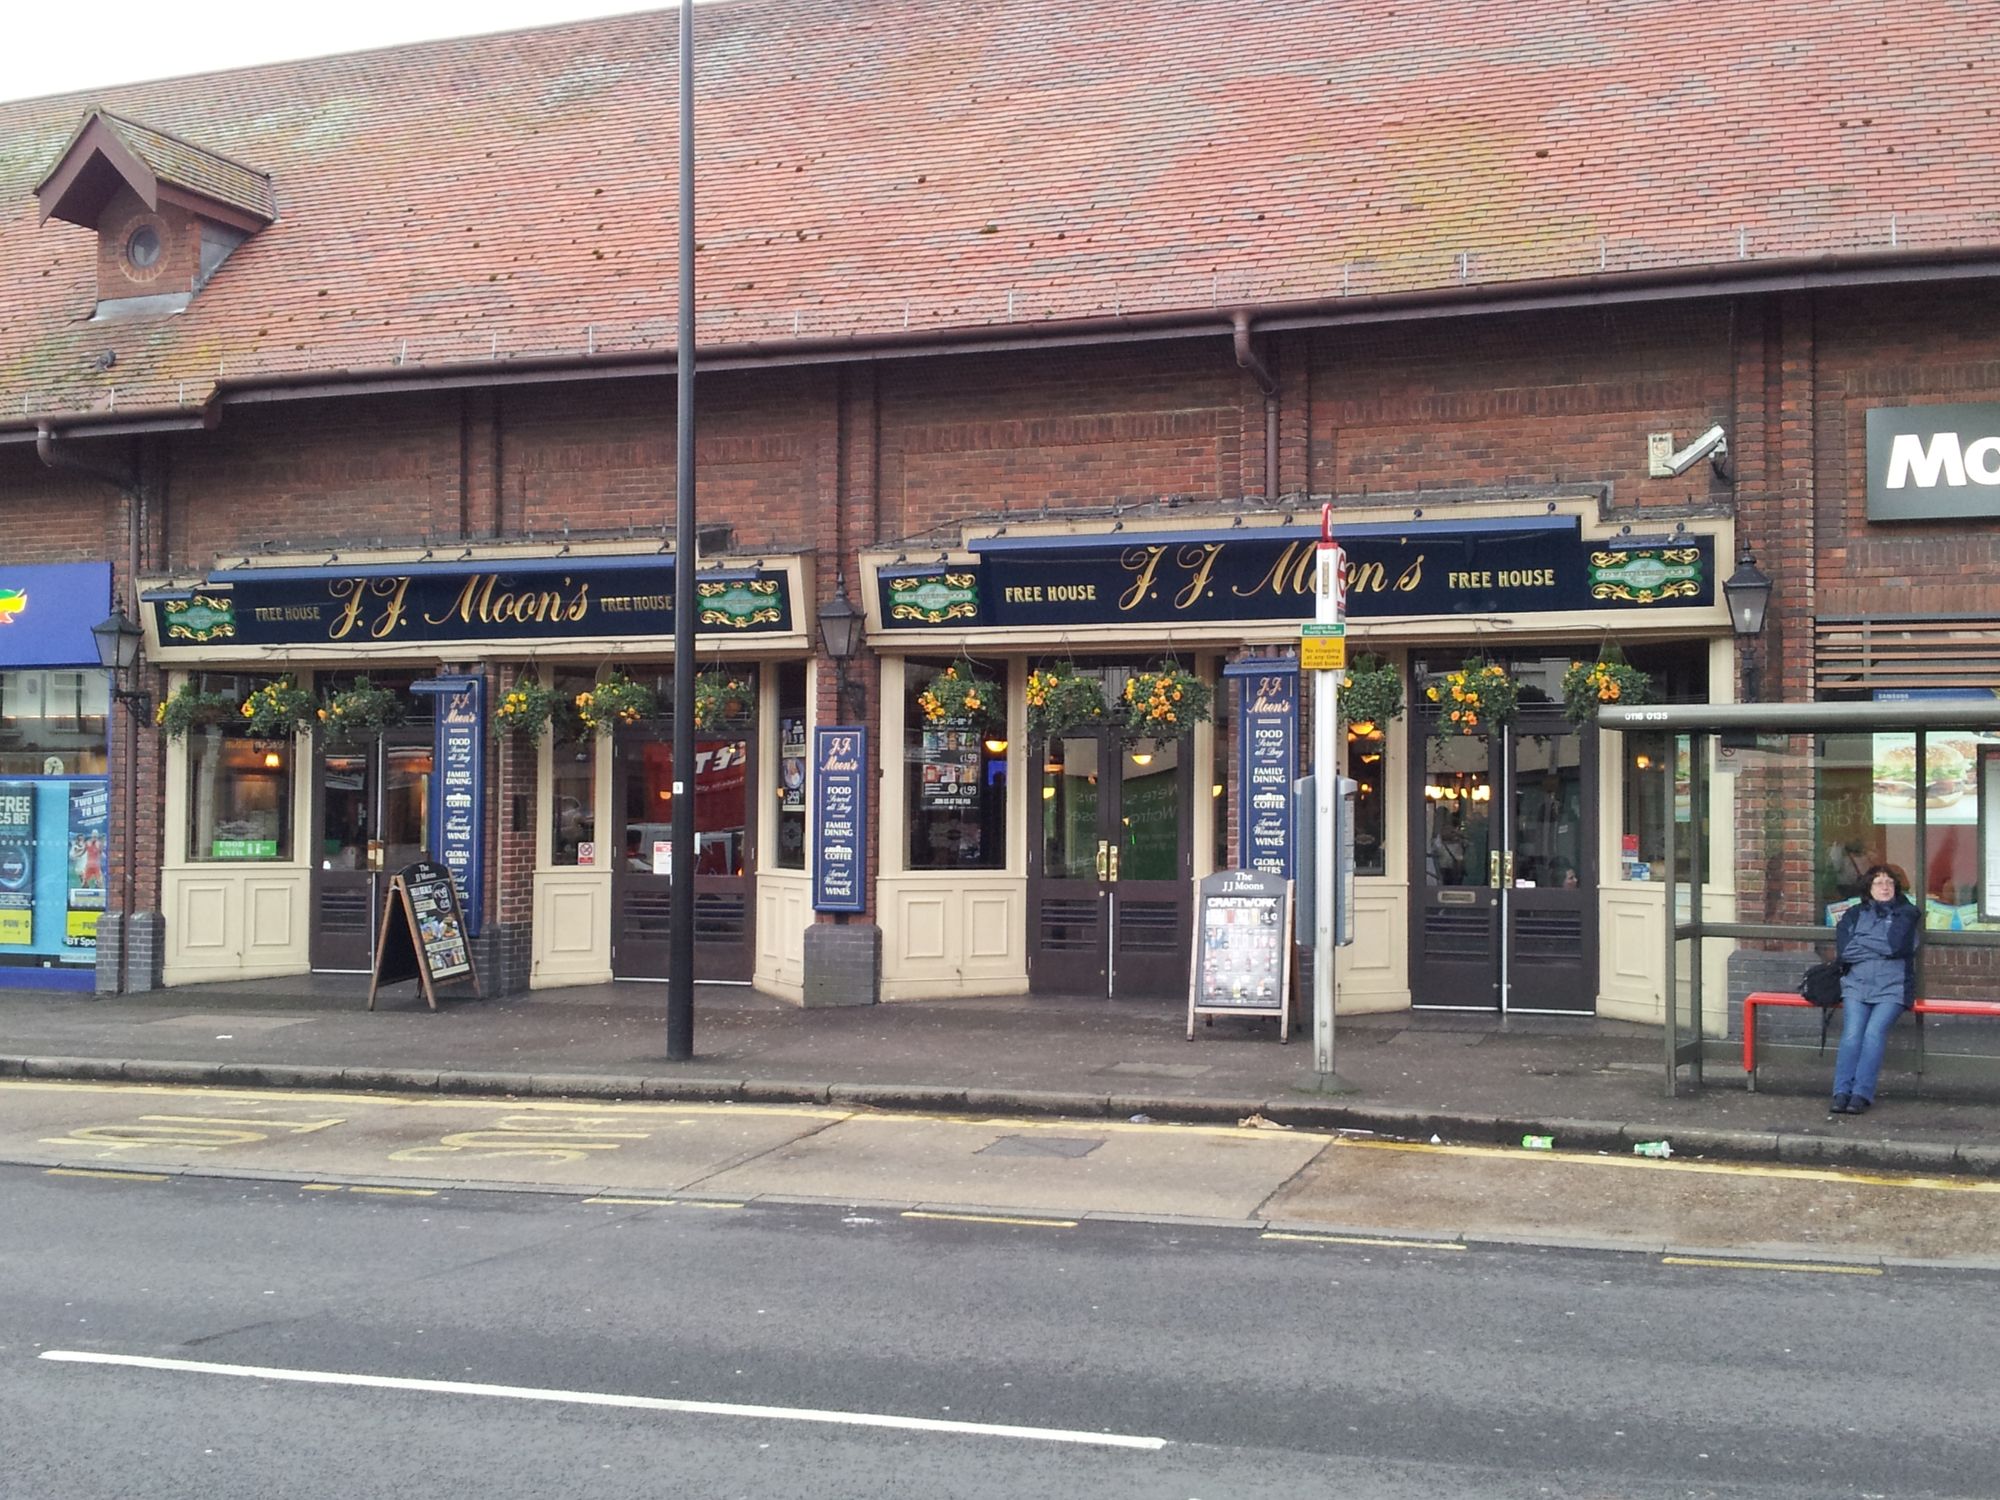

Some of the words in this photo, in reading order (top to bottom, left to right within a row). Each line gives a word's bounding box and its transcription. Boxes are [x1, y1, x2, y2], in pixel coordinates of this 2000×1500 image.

[1005, 587, 1042, 602] FREE
[1048, 585, 1096, 601] HOUSE
[1449, 572, 1492, 589] FREE
[1498, 569, 1555, 587] HOUSE
[255, 608, 284, 622] FREE
[285, 606, 320, 620] HOUSE
[424, 573, 589, 625] Moon's
[600, 597, 631, 612] FREE
[633, 595, 673, 611] HOUSE
[1246, 696, 1290, 713] Moon's
[442, 709, 477, 724] Moon's
[1255, 730, 1283, 739] FOOD
[448, 738, 471, 746] FOOD
[820, 755, 858, 771] Moon's
[1254, 767, 1284, 775] FAMILY
[1253, 775, 1286, 783] DINING
[827, 786, 852, 794] FOOD
[0, 796, 30, 812] FREE
[74, 797, 92, 807] TWO
[1253, 801, 1285, 809] COFFEE
[82, 808, 92, 817] TO
[13, 813, 30, 824] BET
[825, 821, 852, 829] FAMILY
[447, 832, 471, 840] WINES
[1255, 837, 1284, 846] WINES
[1253, 858, 1285, 866] GLOBAL
[419, 864, 429, 872] The
[1235, 872, 1253, 880] The
[1235, 882, 1264, 890] Moons
[825, 887, 851, 896] WINES
[1207, 898, 1277, 908] CRAFTWORK
[66, 937, 79, 946] BT
